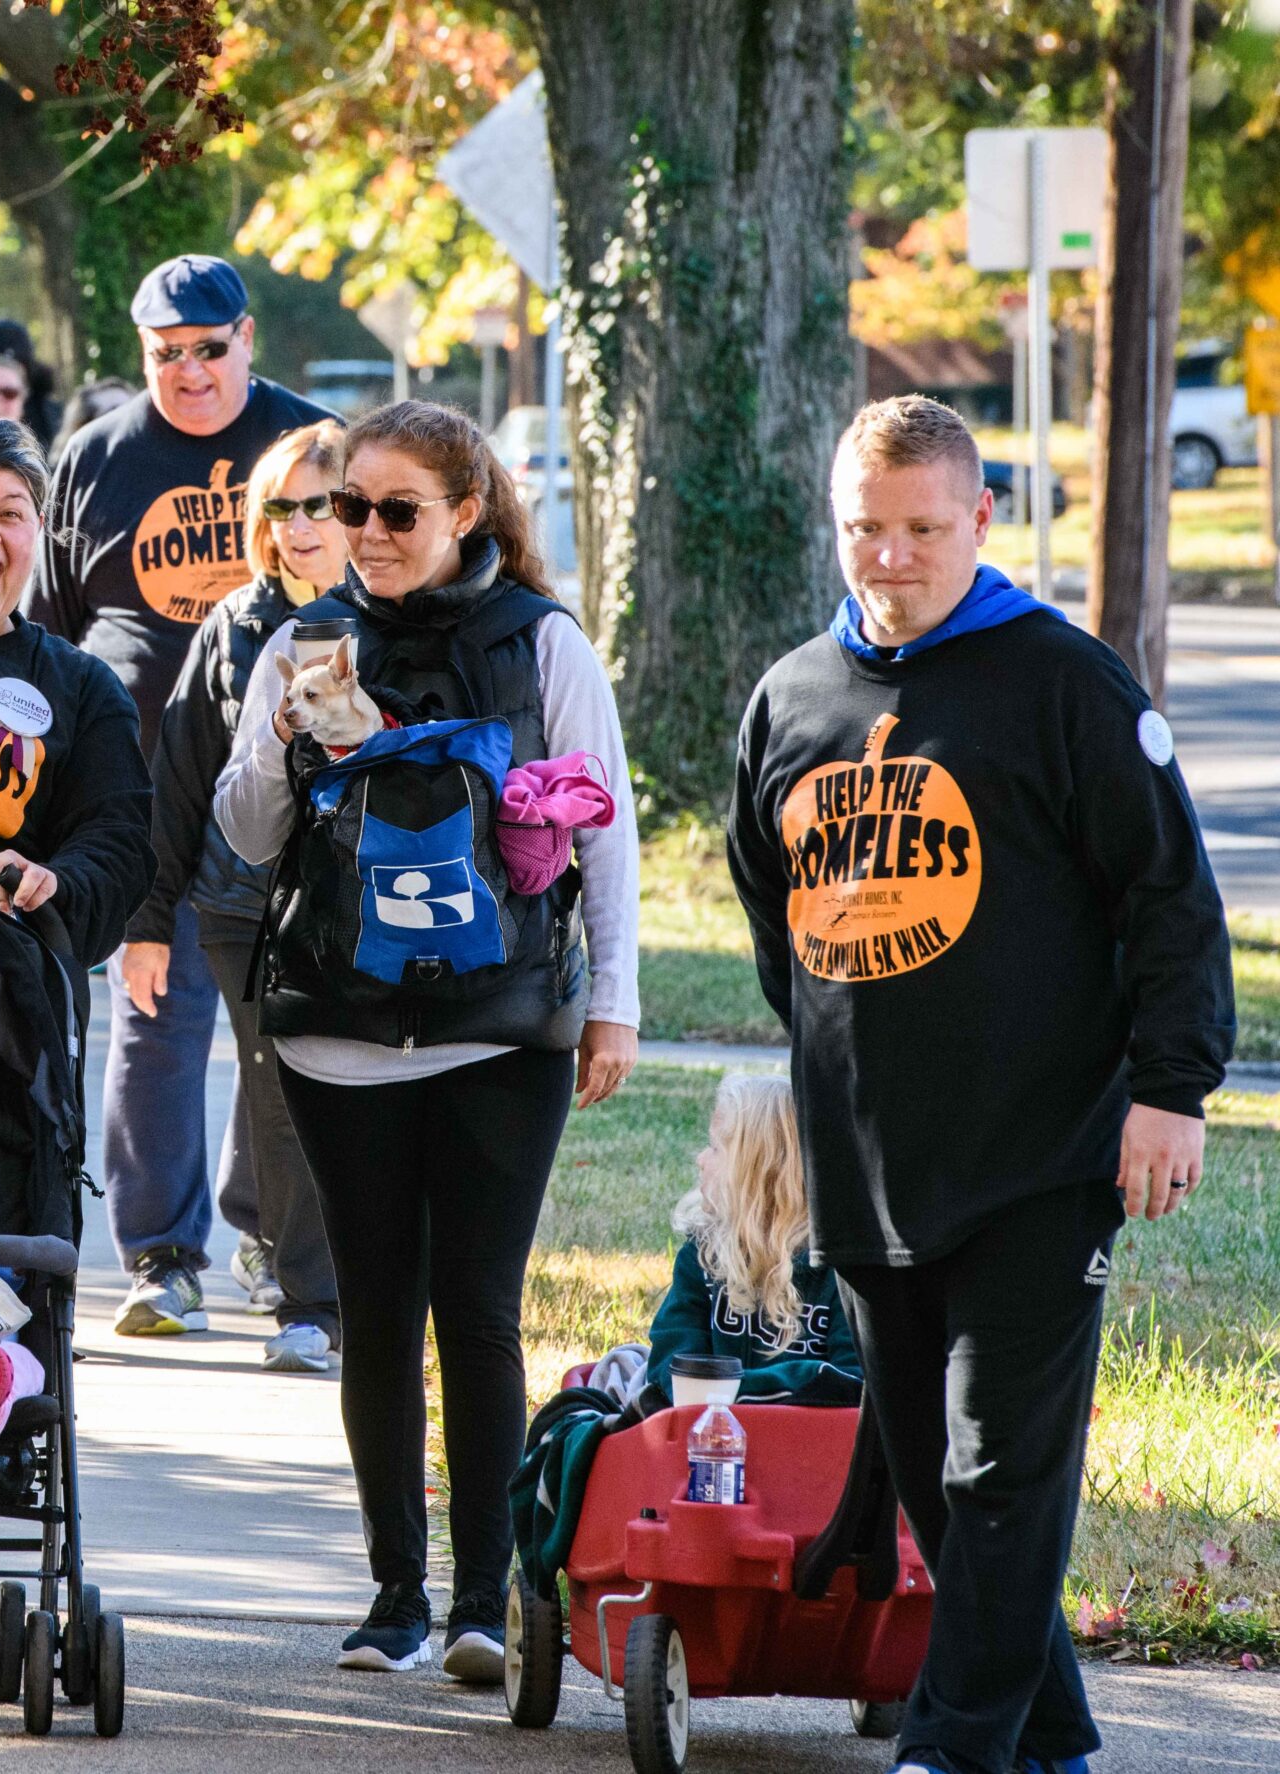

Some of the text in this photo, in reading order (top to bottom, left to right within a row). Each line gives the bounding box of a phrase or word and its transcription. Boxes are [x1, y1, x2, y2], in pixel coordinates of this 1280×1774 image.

[172, 492, 224, 524] HELP
[139, 521, 245, 573] HOMEL
[13, 696, 50, 717] united
[815, 764, 932, 823] HELP THE
[784, 813, 971, 890] HOMELESS
[825, 938, 874, 979] ANNUAL
[873, 933, 898, 976] 5K
[893, 916, 951, 967] WALK
